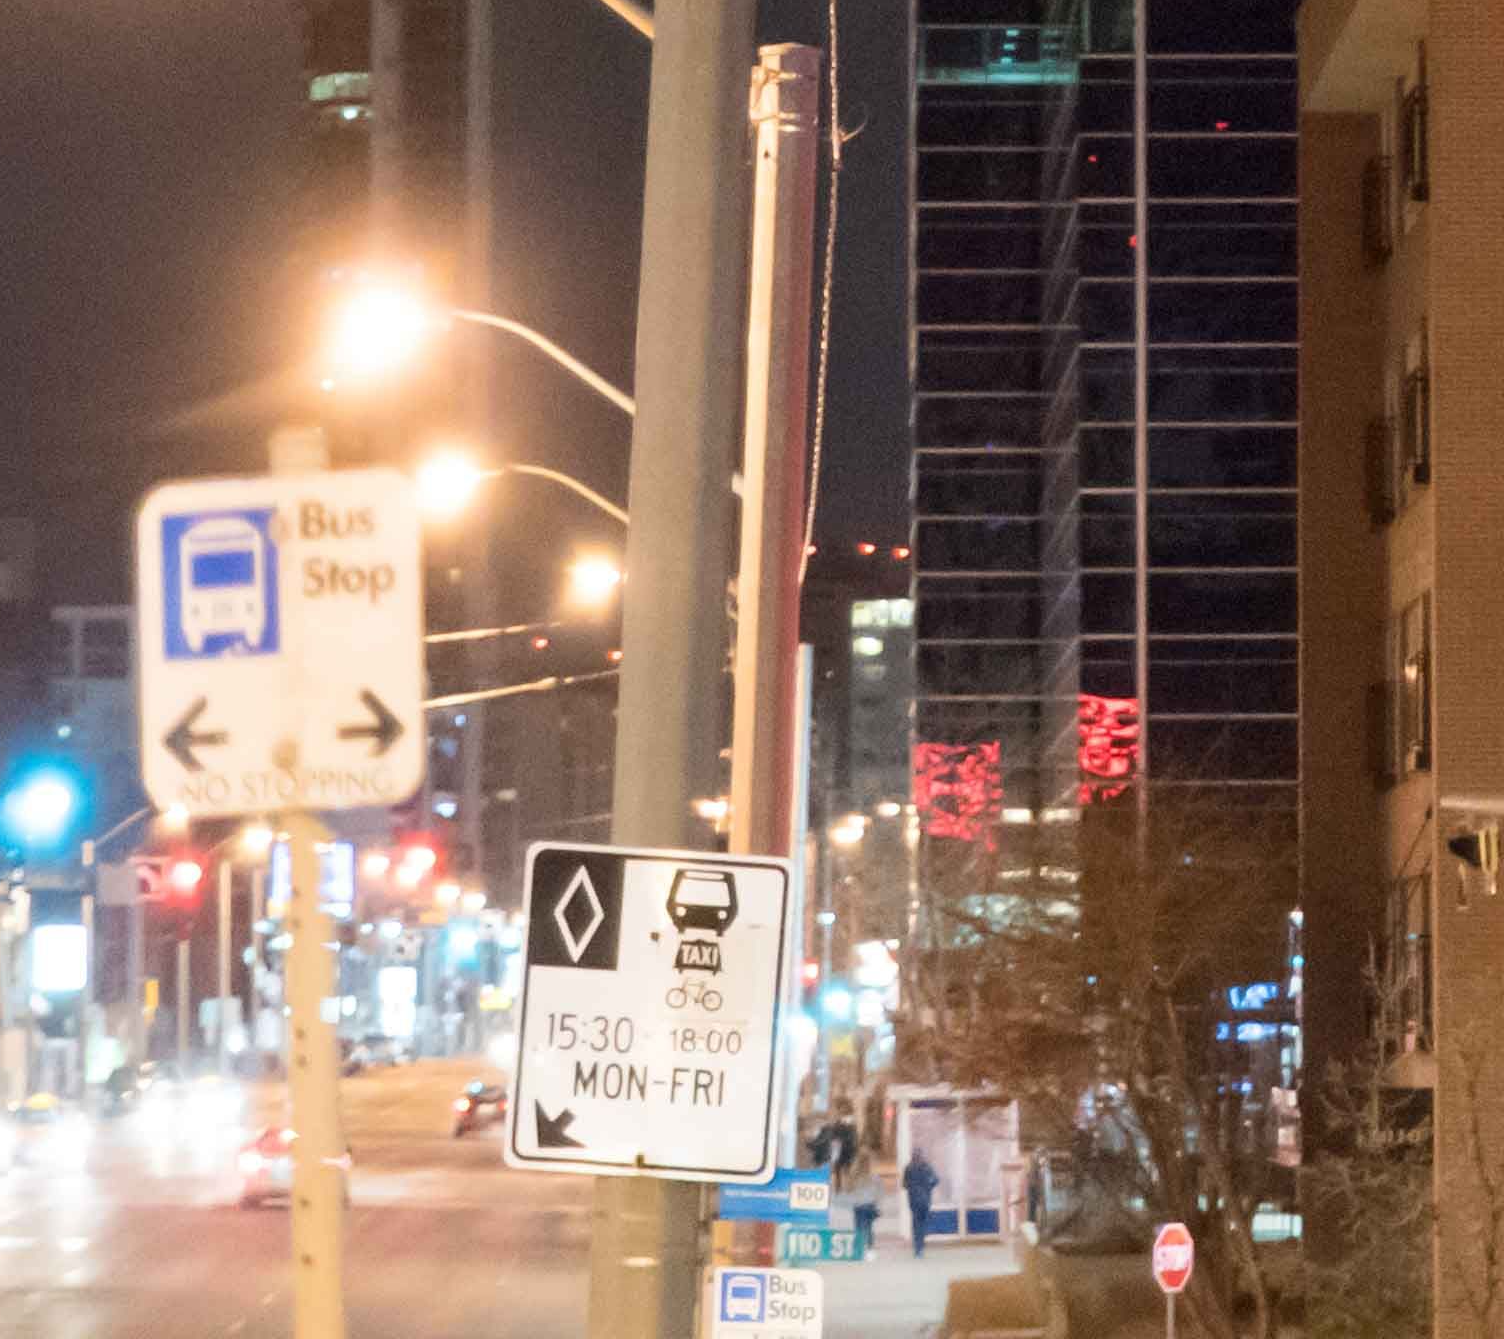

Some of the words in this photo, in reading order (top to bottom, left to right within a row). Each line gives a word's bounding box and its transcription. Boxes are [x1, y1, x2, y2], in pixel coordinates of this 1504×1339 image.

[298, 500, 376, 540] Bus
[301, 557, 396, 605] Stop
[682, 944, 718, 966] TAXI
[549, 1013, 634, 1053] 15:30
[670, 1027, 742, 1054] 18:00
[573, 1060, 725, 1107] MON-FRI
[830, 1233, 856, 1259] ST
[768, 1274, 809, 1296] Bus
[767, 1299, 817, 1323] Stop
